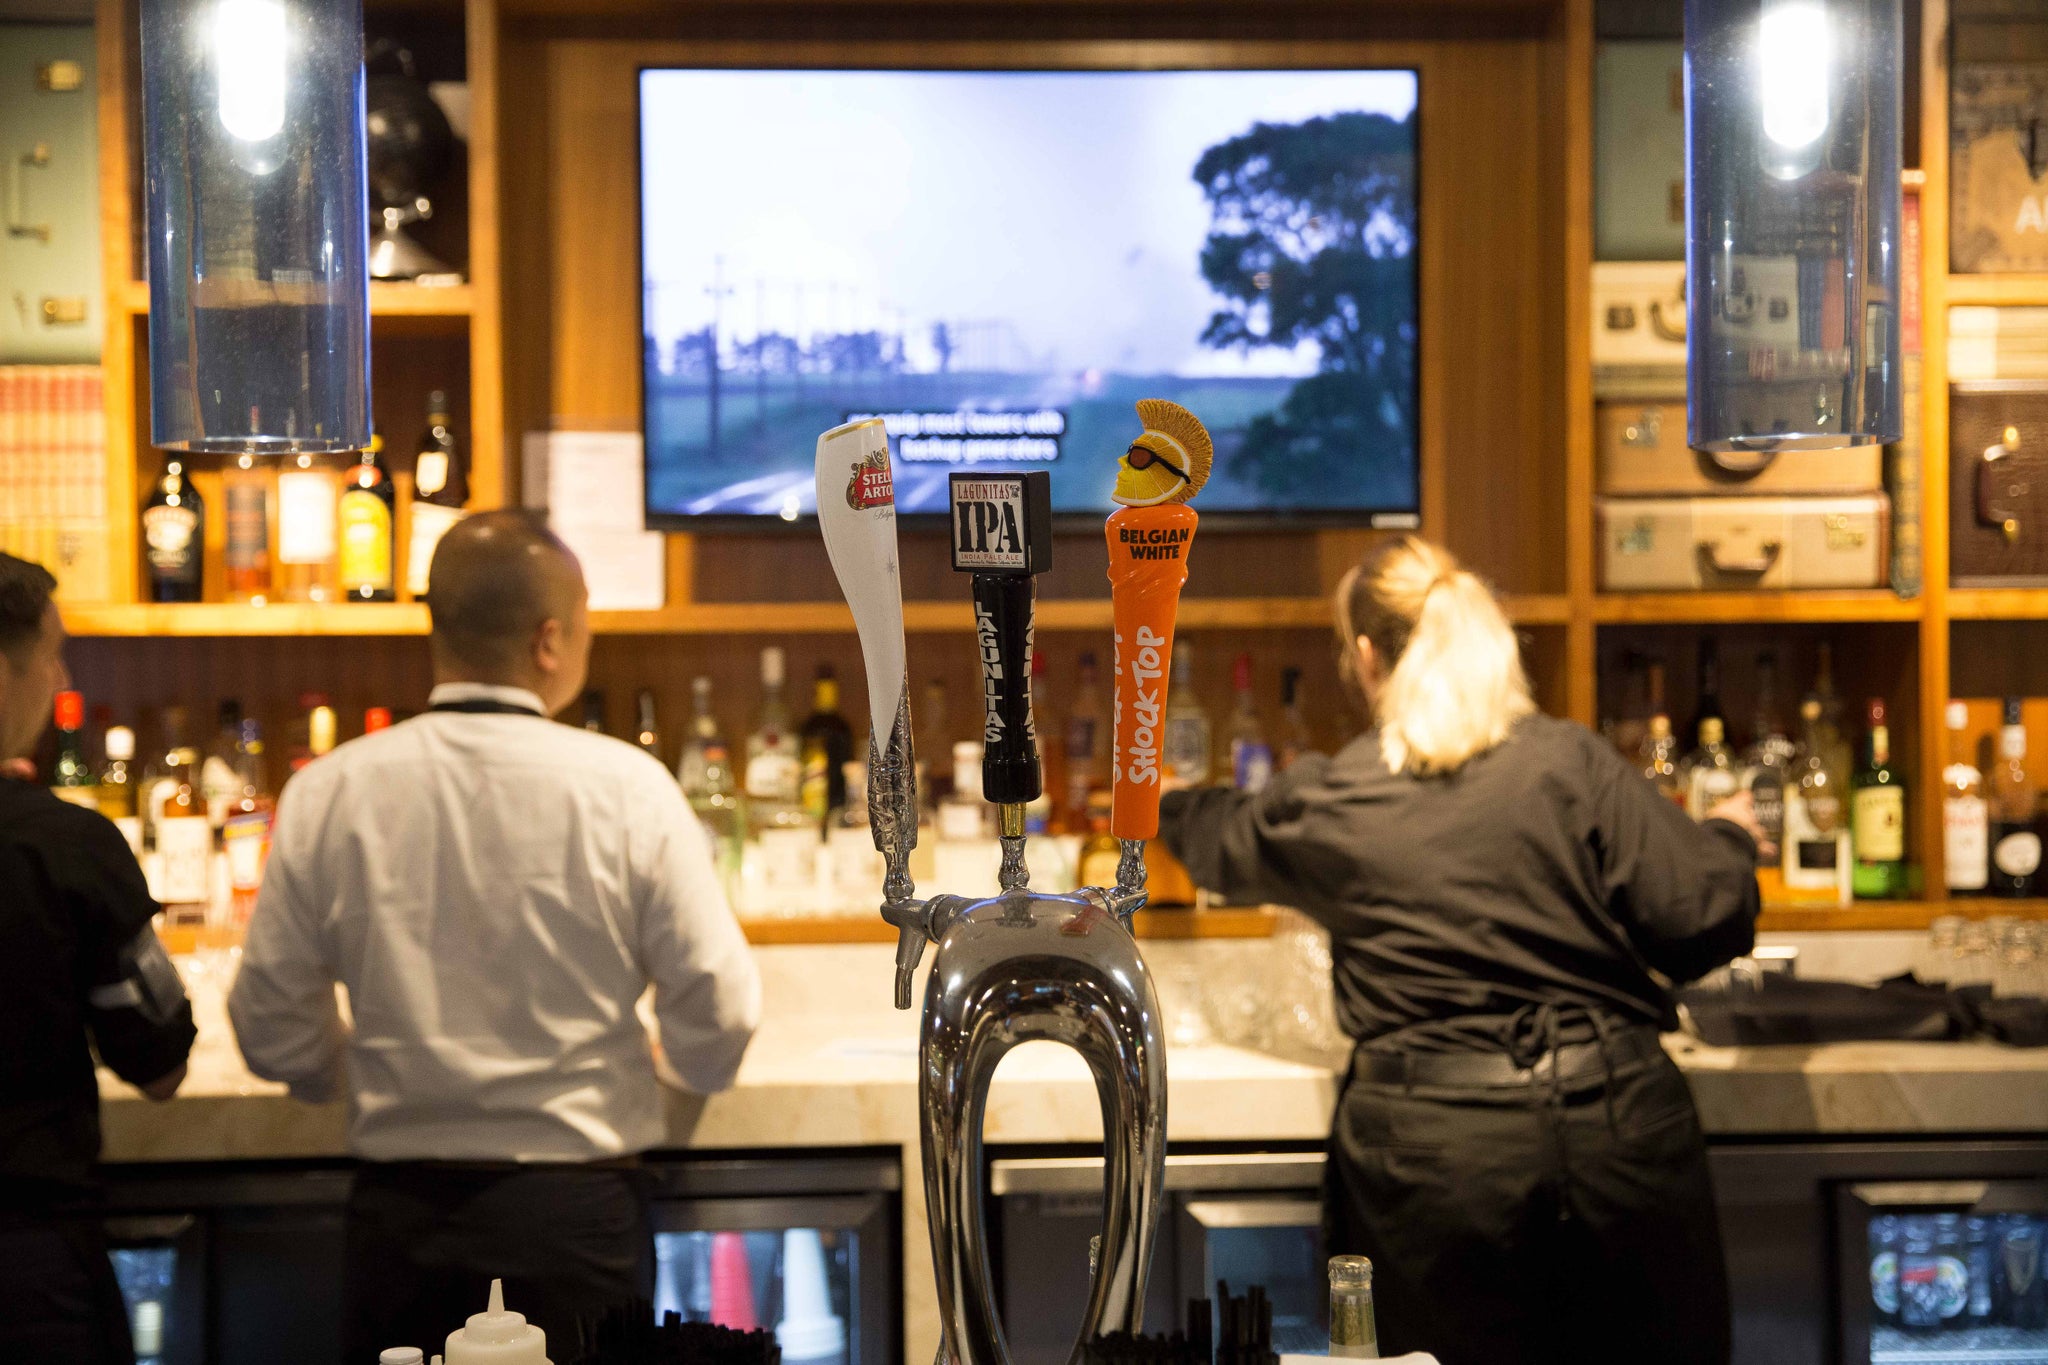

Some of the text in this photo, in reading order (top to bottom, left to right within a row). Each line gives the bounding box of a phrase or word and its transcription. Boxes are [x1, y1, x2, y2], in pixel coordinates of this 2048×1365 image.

[957, 484, 1010, 499] LAGUNITAS
[956, 501, 1022, 553] IPA
[1120, 528, 1190, 545] BELGIAN
[1130, 545, 1180, 560] WHITE
[976, 601, 1006, 742] LAGUNITAS
[1128, 625, 1165, 786] SHOCK TOP
